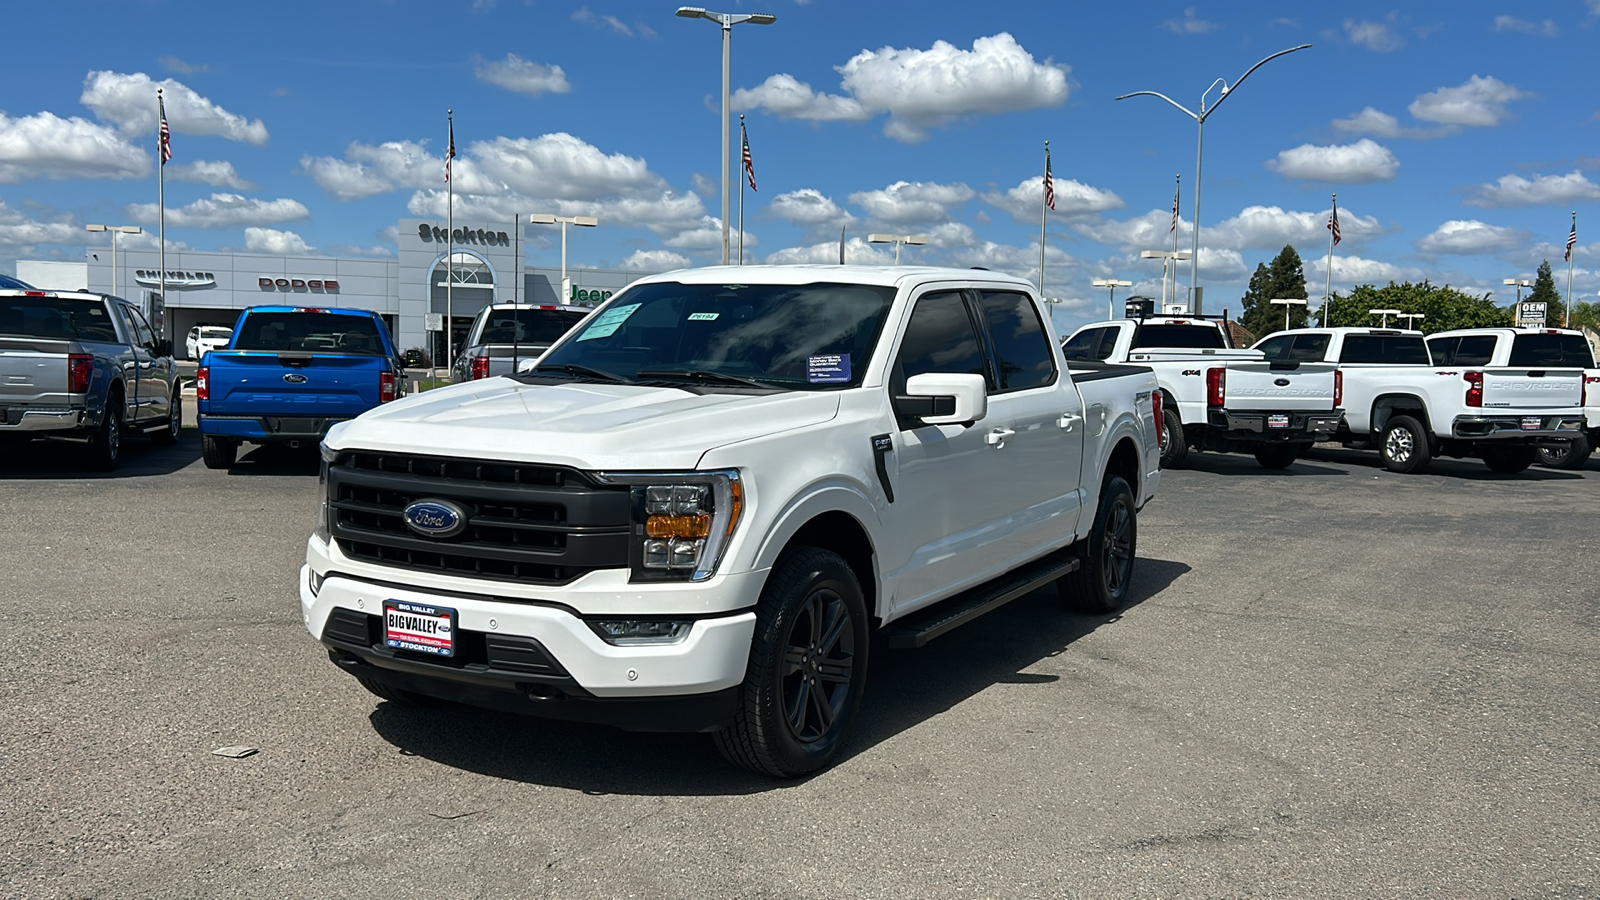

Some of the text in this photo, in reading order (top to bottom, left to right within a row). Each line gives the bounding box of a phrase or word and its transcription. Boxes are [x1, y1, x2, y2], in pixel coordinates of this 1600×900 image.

[418, 223, 509, 244] Stockton
[136, 269, 215, 281] CHRYSLER
[258, 277, 338, 290] DODGE
[570, 284, 613, 304] Jeep
[1522, 303, 1545, 312] OEM
[1232, 388, 1287, 396] SUPER
[1490, 382, 1577, 391] CHEVROLET
[415, 508, 445, 527] Ford
[398, 603, 436, 615] BIG VALLEY
[388, 613, 438, 635] BIGVALLEY
[399, 641, 439, 653] STOCKTON
